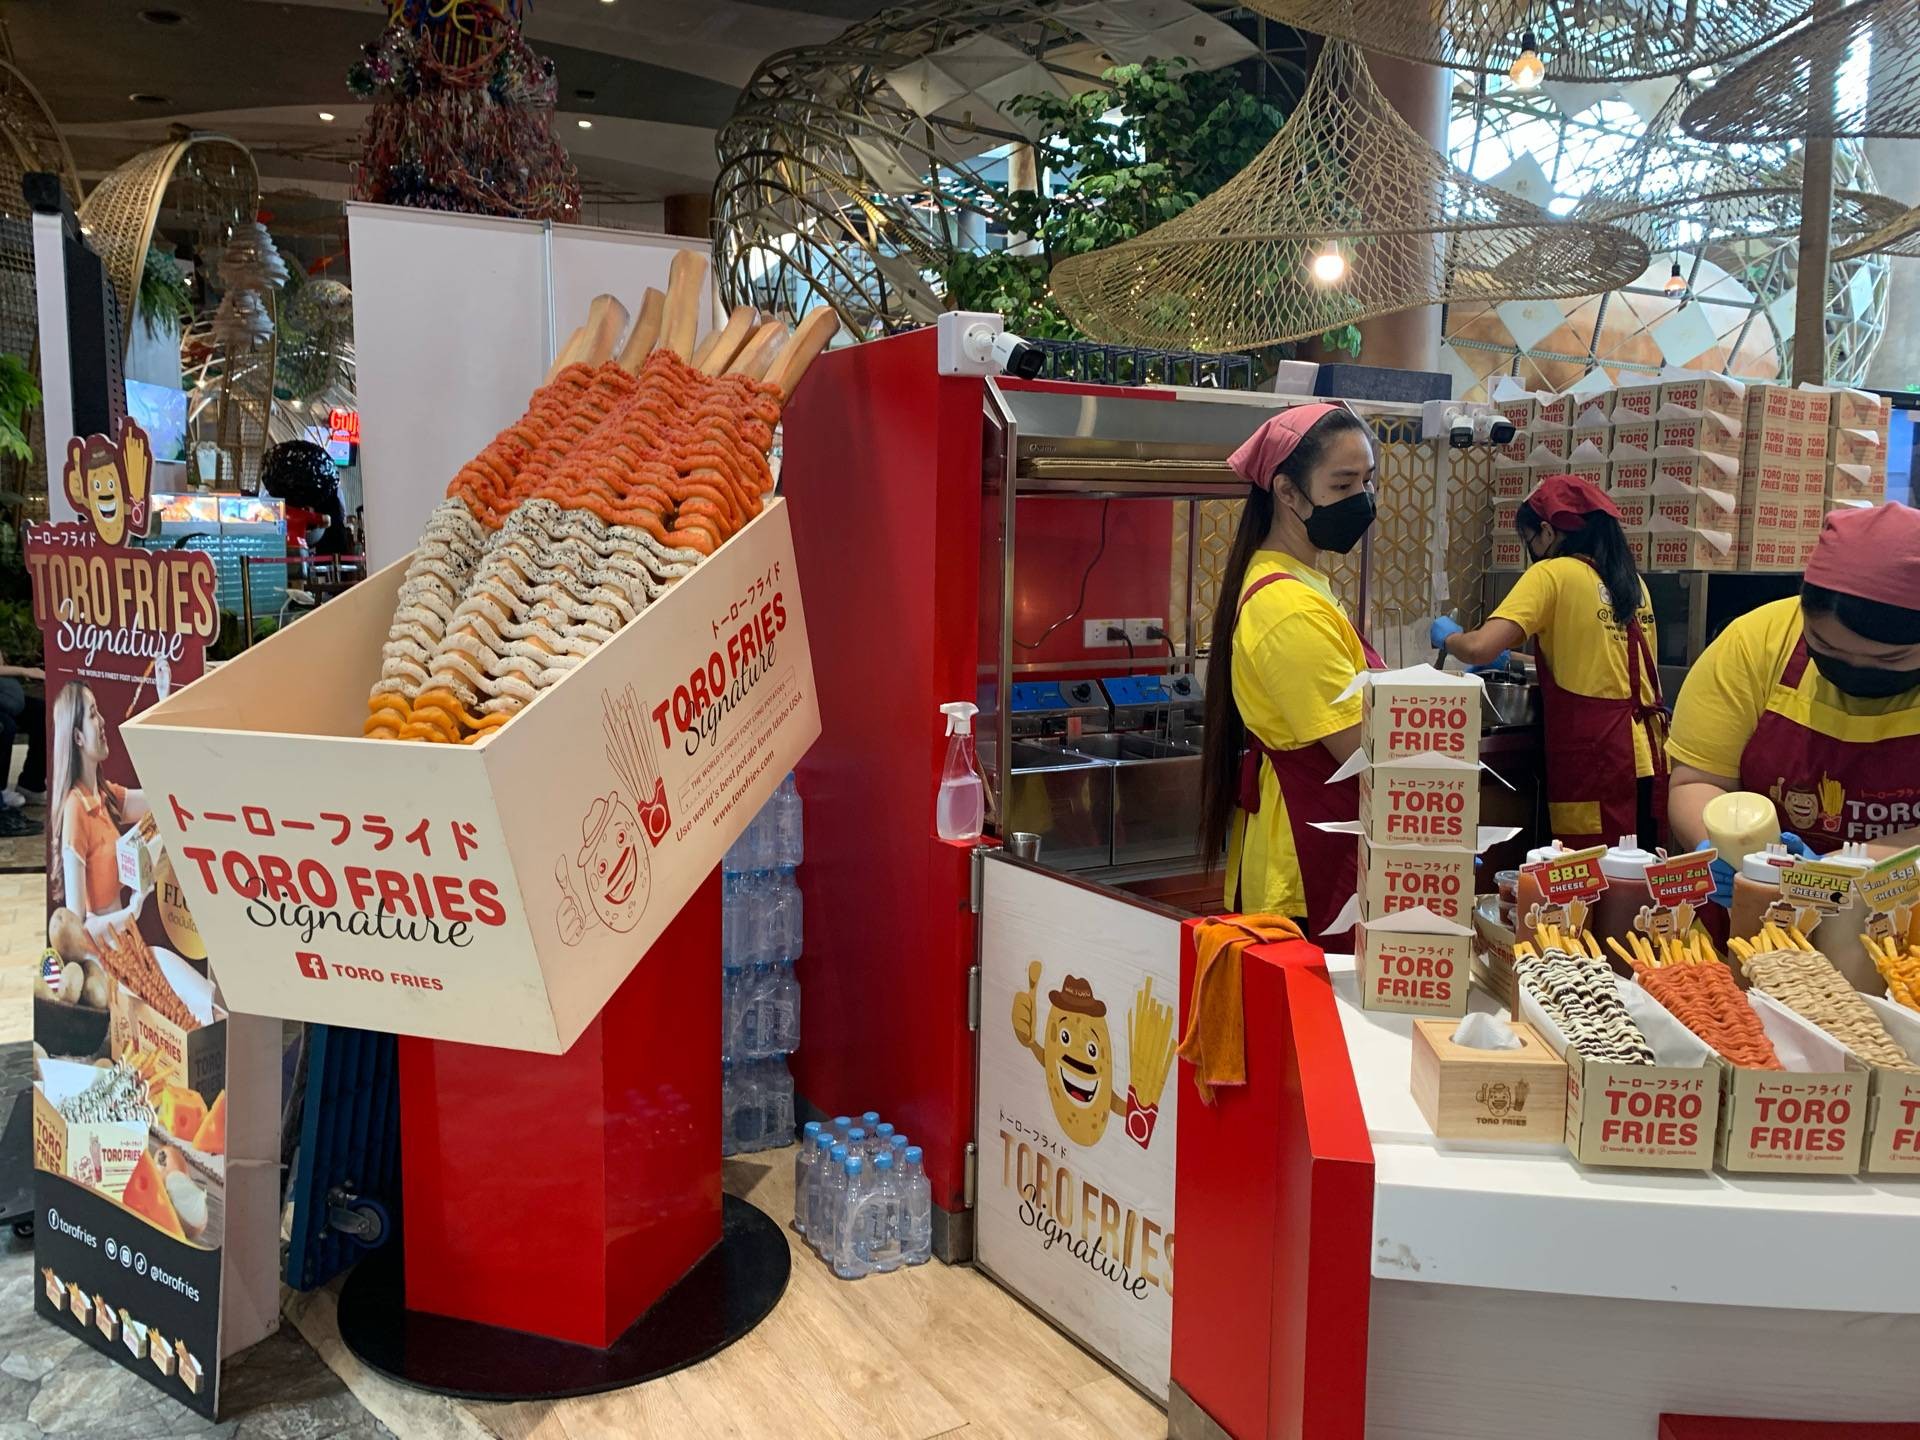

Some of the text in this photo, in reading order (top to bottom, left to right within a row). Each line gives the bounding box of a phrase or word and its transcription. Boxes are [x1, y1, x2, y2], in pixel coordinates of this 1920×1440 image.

[1668, 390, 1697, 400] TORO
[1769, 394, 1787, 406] TORO
[1622, 396, 1651, 407] TORO
[1810, 402, 1827, 411] TORO
[1504, 409, 1527, 418] TORO
[1767, 405, 1786, 416] FRIES
[1809, 412, 1827, 421] FRIES
[1620, 433, 1648, 444] TORO
[1664, 427, 1695, 438] TORO
[1766, 431, 1784, 443] TORO
[1764, 443, 1783, 453] FRIES
[1808, 438, 1825, 447] TORO
[1807, 448, 1824, 457] FRIES
[1618, 468, 1647, 478] TORO
[1662, 466, 1692, 476] TORO
[1762, 469, 1781, 479] TORO
[1500, 477, 1523, 486] TORO
[1617, 479, 1646, 488] FRIES
[1806, 474, 1823, 483] TORO
[1499, 487, 1522, 495] FRIES
[1761, 480, 1779, 490] FRIES
[1805, 484, 1822, 493] FRIES
[1659, 506, 1689, 516] TORO
[1759, 506, 1778, 516] TORO
[1780, 509, 1797, 519] TORO
[1803, 509, 1820, 518] TORO
[1758, 517, 1777, 527] FRIES
[1779, 520, 1796, 529] FRIES
[1803, 520, 1820, 528] FRIES
[26, 530, 97, 548] トーローフライド
[1497, 544, 1520, 553] TORO
[1657, 543, 1687, 552] TORO
[1757, 543, 1775, 553] TORO
[1778, 545, 1795, 554] TORO
[1497, 554, 1520, 562] FRIES
[1656, 554, 1686, 562] FRIES
[1756, 554, 1774, 563] FRIES
[1776, 556, 1794, 564] FRIES
[30, 553, 214, 637] TORO FRIES
[712, 561, 780, 639] トーローフライド
[57, 598, 184, 667] Signature
[651, 592, 786, 750] TORO FRIES
[685, 640, 777, 756] Signature
[1390, 707, 1467, 729] TORO
[1390, 731, 1465, 752] FRIES
[676, 820, 692, 842] Use
[693, 789, 720, 823] world's
[720, 768, 735, 792] best
[736, 744, 758, 777] potato
[772, 708, 789, 731] Idaho
[789, 691, 802, 711] USA
[712, 750, 775, 827] www.torofries.com
[1388, 790, 1464, 813] TORO
[168, 793, 479, 861] トーローフライド
[1388, 814, 1463, 835] FRIES
[1549, 864, 1590, 883] BBQ
[1651, 867, 1708, 885] Spicy Zab
[183, 846, 506, 926] TORO FRIES
[1384, 871, 1461, 895] TORO
[1550, 881, 1584, 893] CHEESE
[1782, 870, 1850, 892] TRUFFLE
[1660, 885, 1693, 896] CHEESE
[1791, 887, 1828, 900] CHEESE
[246, 877, 474, 947] Signature
[1379, 954, 1453, 978] TORO
[332, 963, 443, 991] TORO FRIES
[1378, 978, 1451, 1000] FRIES
[1608, 1075, 1704, 1090] トーローフライド
[1759, 1082, 1853, 1096] トーローフライド
[1605, 1090, 1702, 1119] TORO
[1755, 1097, 1851, 1124] TORO
[1476, 1117, 1499, 1125] TORO
[36, 1116, 62, 1160] TORO
[1000, 1109, 1067, 1159] トーローフライド
[1602, 1120, 1698, 1146] FRIES
[1750, 1126, 1846, 1151] FRIES
[102, 1148, 122, 1162] TORO
[1000, 1129, 1074, 1229] TORO
[60, 1219, 97, 1248] torofries
[1018, 1183, 1148, 1300] Signature
[151, 1265, 200, 1302] @torofries
